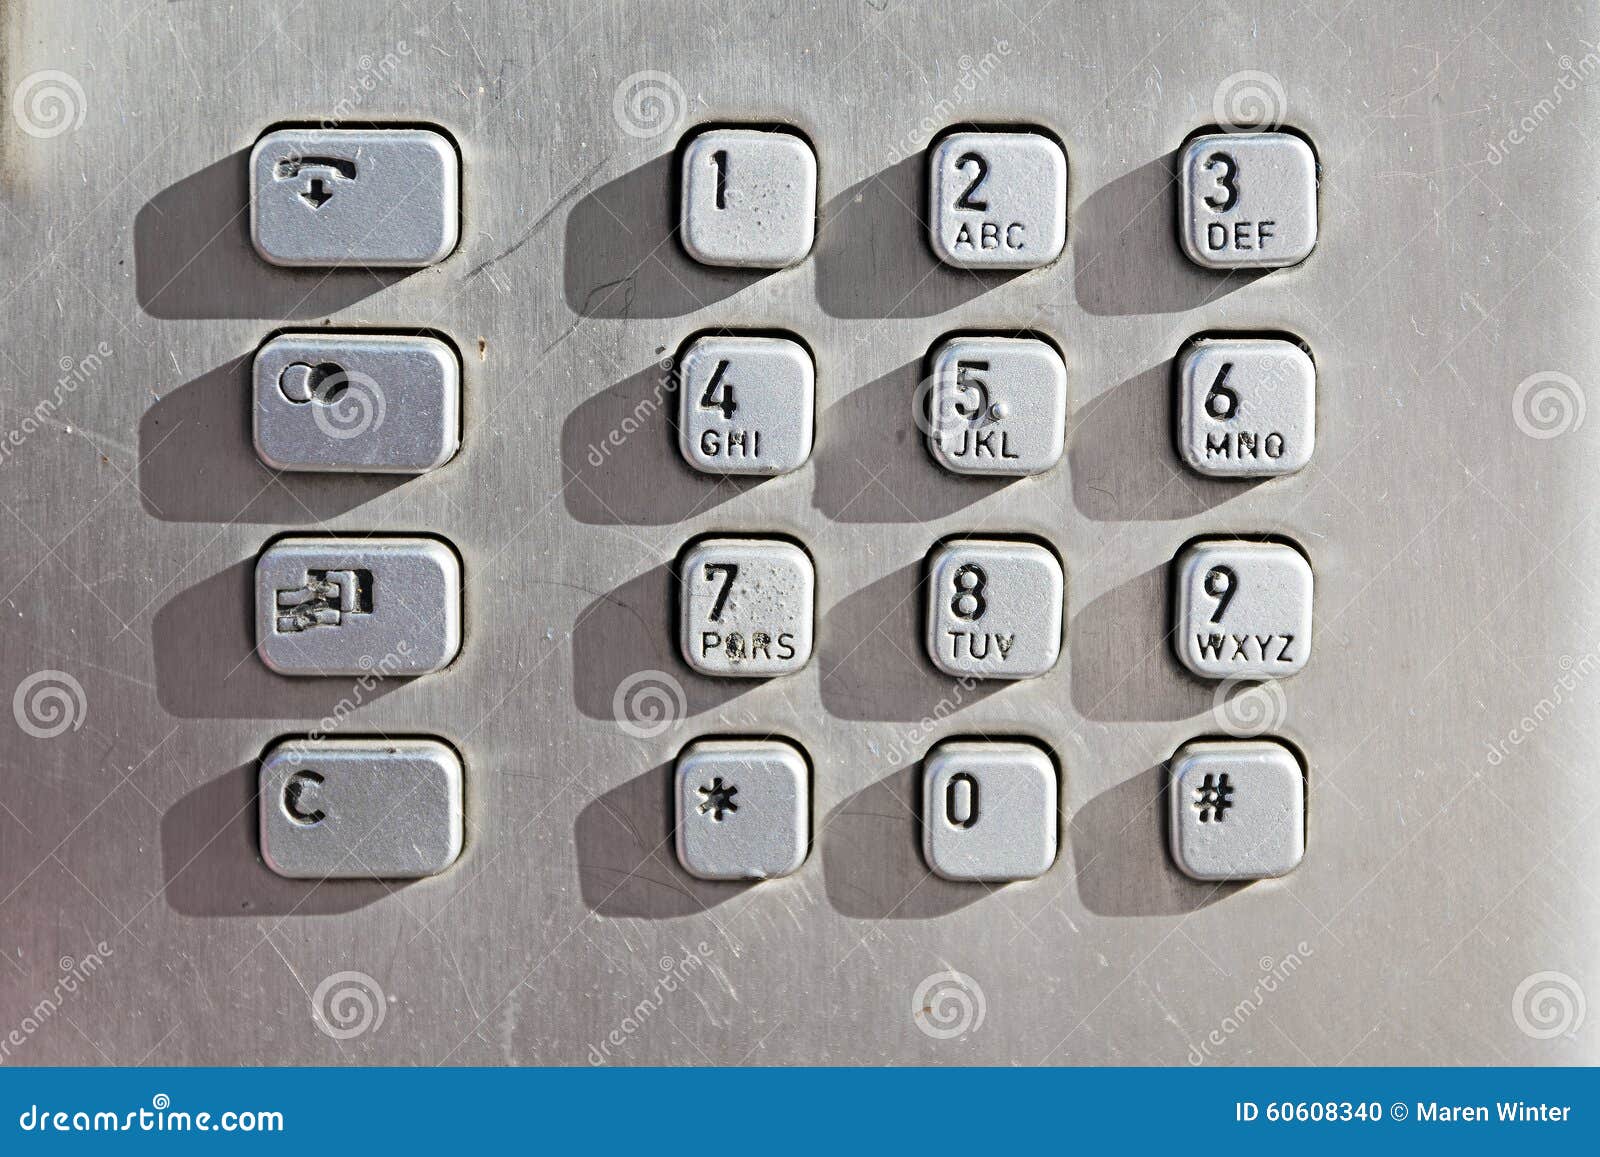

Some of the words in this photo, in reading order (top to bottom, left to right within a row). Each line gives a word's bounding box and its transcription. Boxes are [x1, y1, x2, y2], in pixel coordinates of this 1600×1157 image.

[710, 149, 729, 211] 1
[955, 151, 988, 213] 2
[1203, 151, 1240, 214] 3
[953, 221, 1025, 252] ABC
[1207, 220, 1277, 252] DEF
[700, 359, 738, 420] 4
[954, 360, 992, 422] 5
[1204, 362, 1240, 422] 6
[700, 428, 761, 458] GHI
[953, 429, 1020, 460] JKL
[1206, 431, 1285, 459] MNO
[704, 562, 739, 622] 7
[950, 563, 988, 623] 8
[1203, 564, 1239, 624] 9
[702, 631, 796, 662] PQRS
[947, 631, 1016, 661] TUV
[1196, 633, 1295, 662] WXYZ
[283, 769, 326, 825] C
